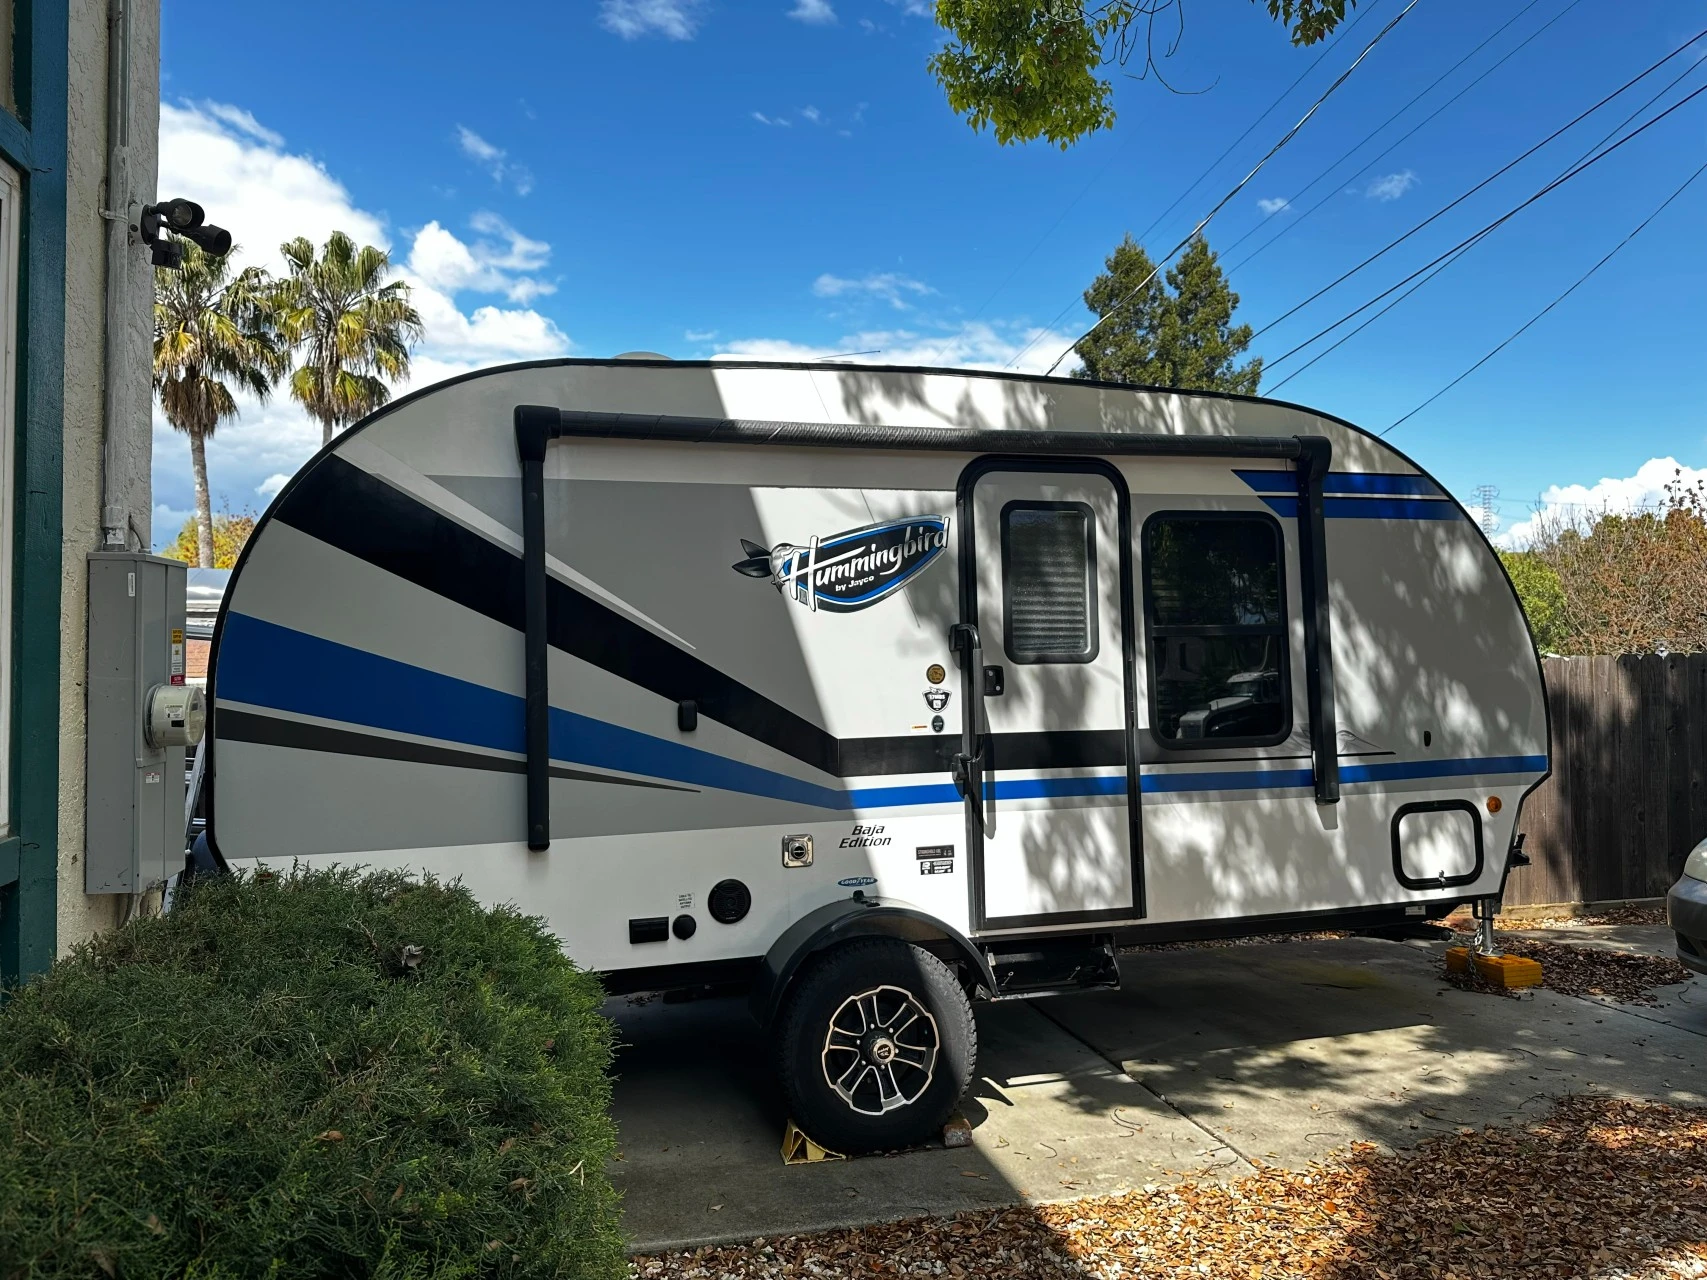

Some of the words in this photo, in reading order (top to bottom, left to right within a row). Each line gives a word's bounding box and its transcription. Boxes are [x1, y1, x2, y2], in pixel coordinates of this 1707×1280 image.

[781, 517, 950, 612] Hummingbird
[848, 576, 875, 587] Jayco
[851, 825, 885, 836] Baja
[839, 837, 892, 848] Edition
